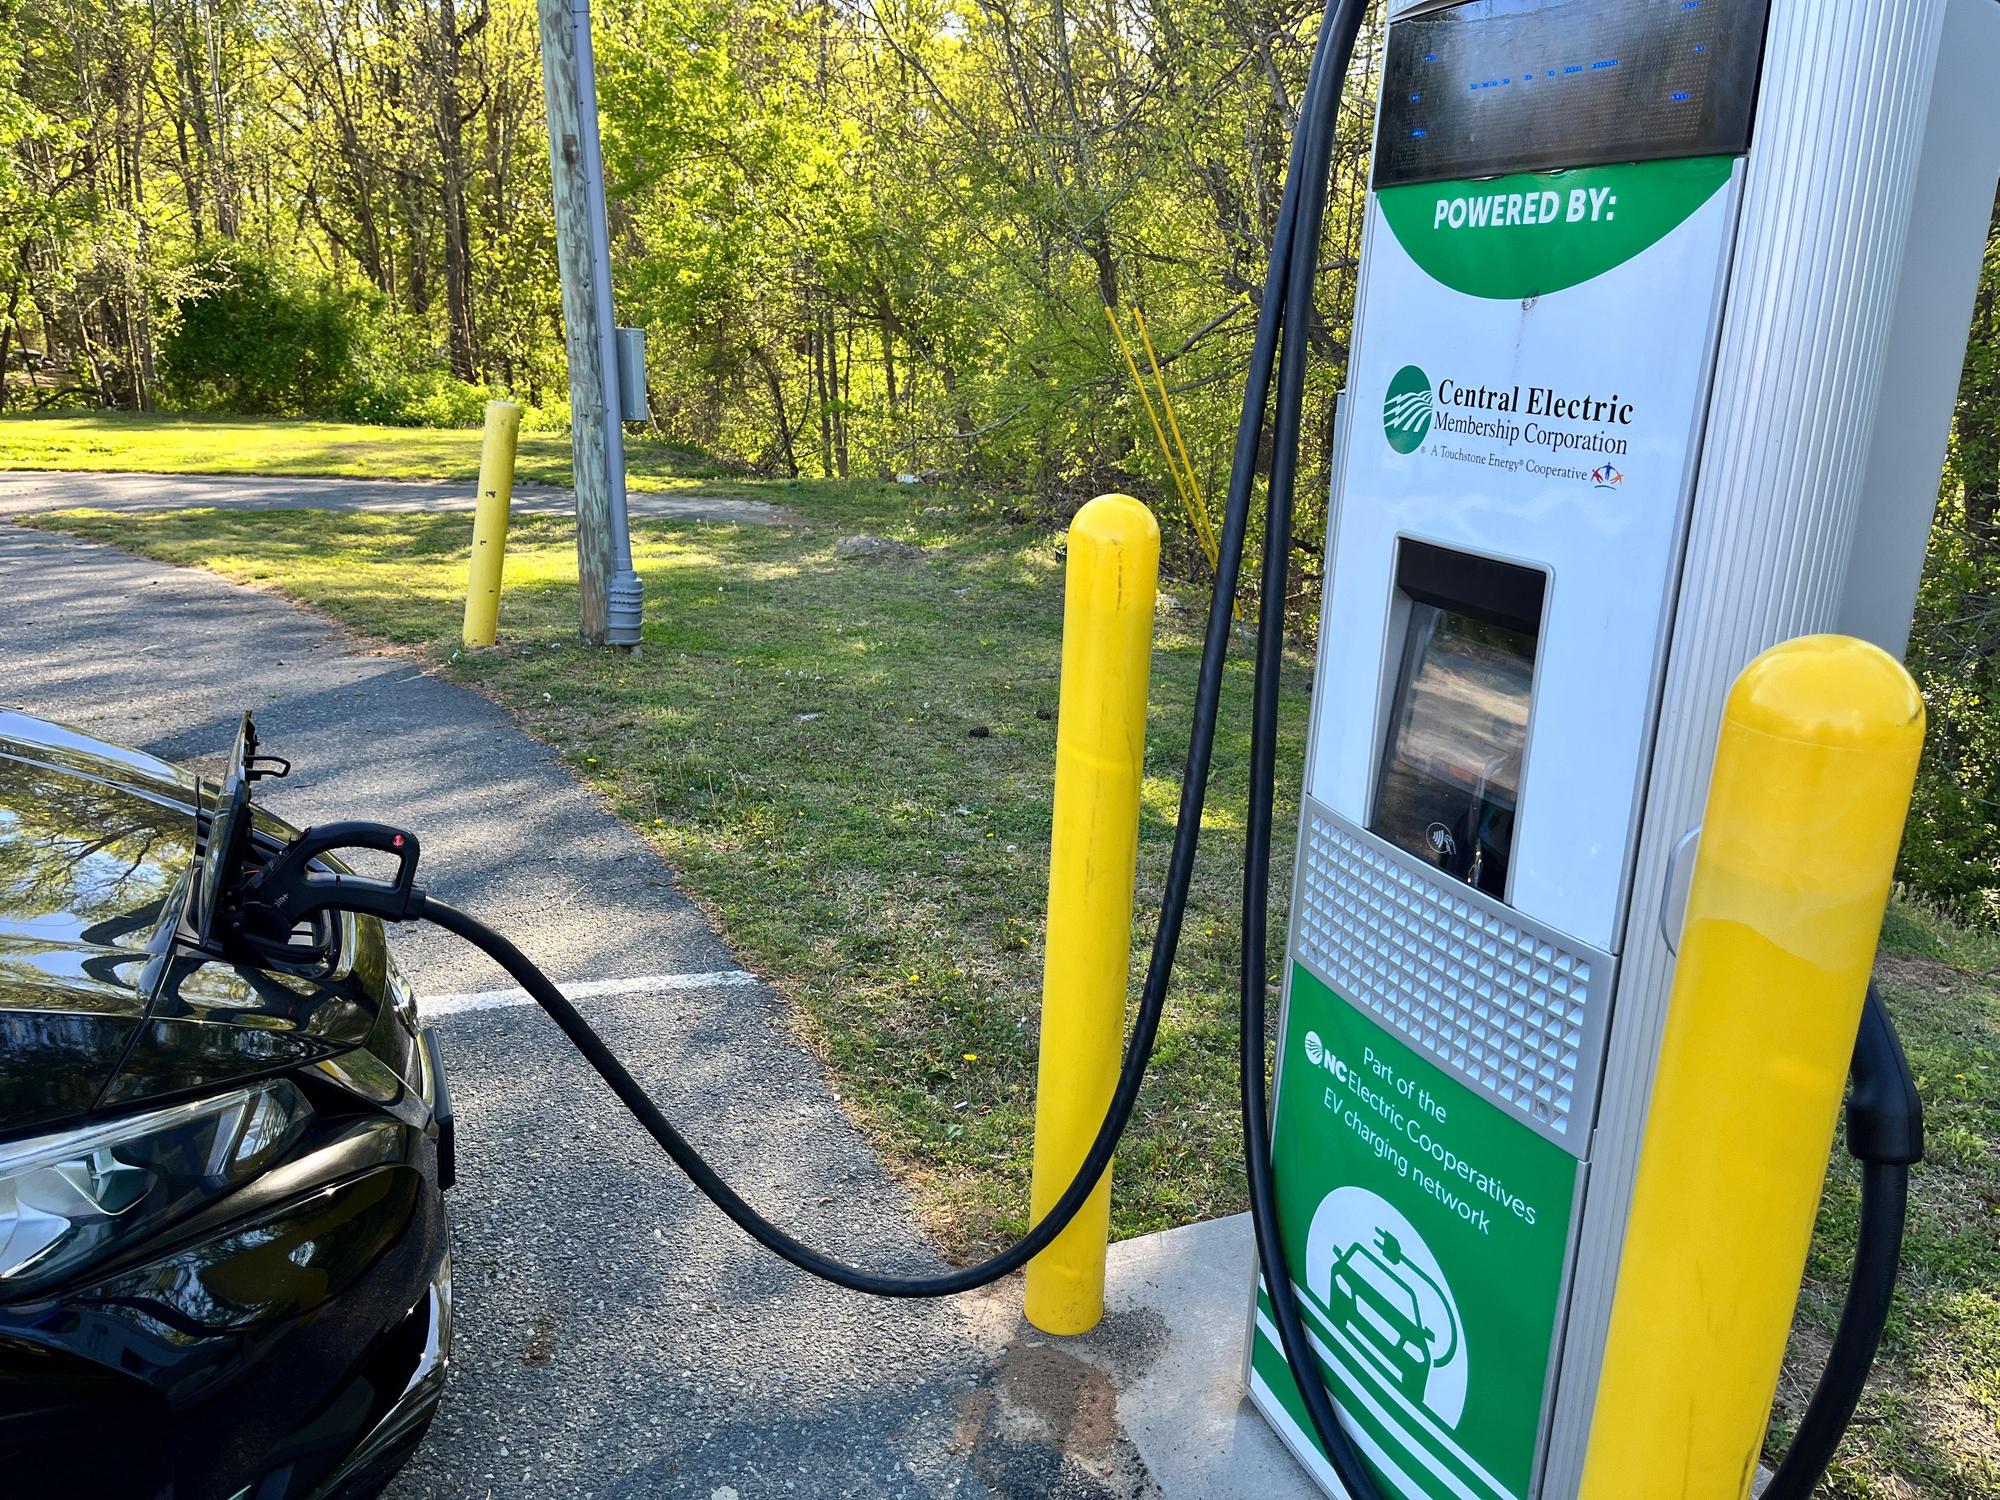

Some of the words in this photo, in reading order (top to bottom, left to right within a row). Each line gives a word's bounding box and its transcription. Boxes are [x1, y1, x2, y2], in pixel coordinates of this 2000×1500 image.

[1433, 191, 1559, 229] POWERED
[1566, 187, 1617, 223] BY:
[1438, 379, 1520, 412] Central
[1525, 387, 1634, 425] Electric
[1434, 411, 1520, 446] Membership
[1524, 422, 1628, 455] Corporation
[1430, 444, 1438, 457] A
[1441, 445, 1487, 465] Touchstone
[1525, 459, 1588, 481] Cooperative
[1363, 1046, 1393, 1086] Part
[1396, 1077, 1416, 1099] of
[1418, 1089, 1447, 1124] the
[1324, 1086, 1343, 1114] EV
[1344, 1109, 1408, 1177] charging
[1412, 1166, 1491, 1235] network
[1406, 1119, 1537, 1225] Cooperatives
